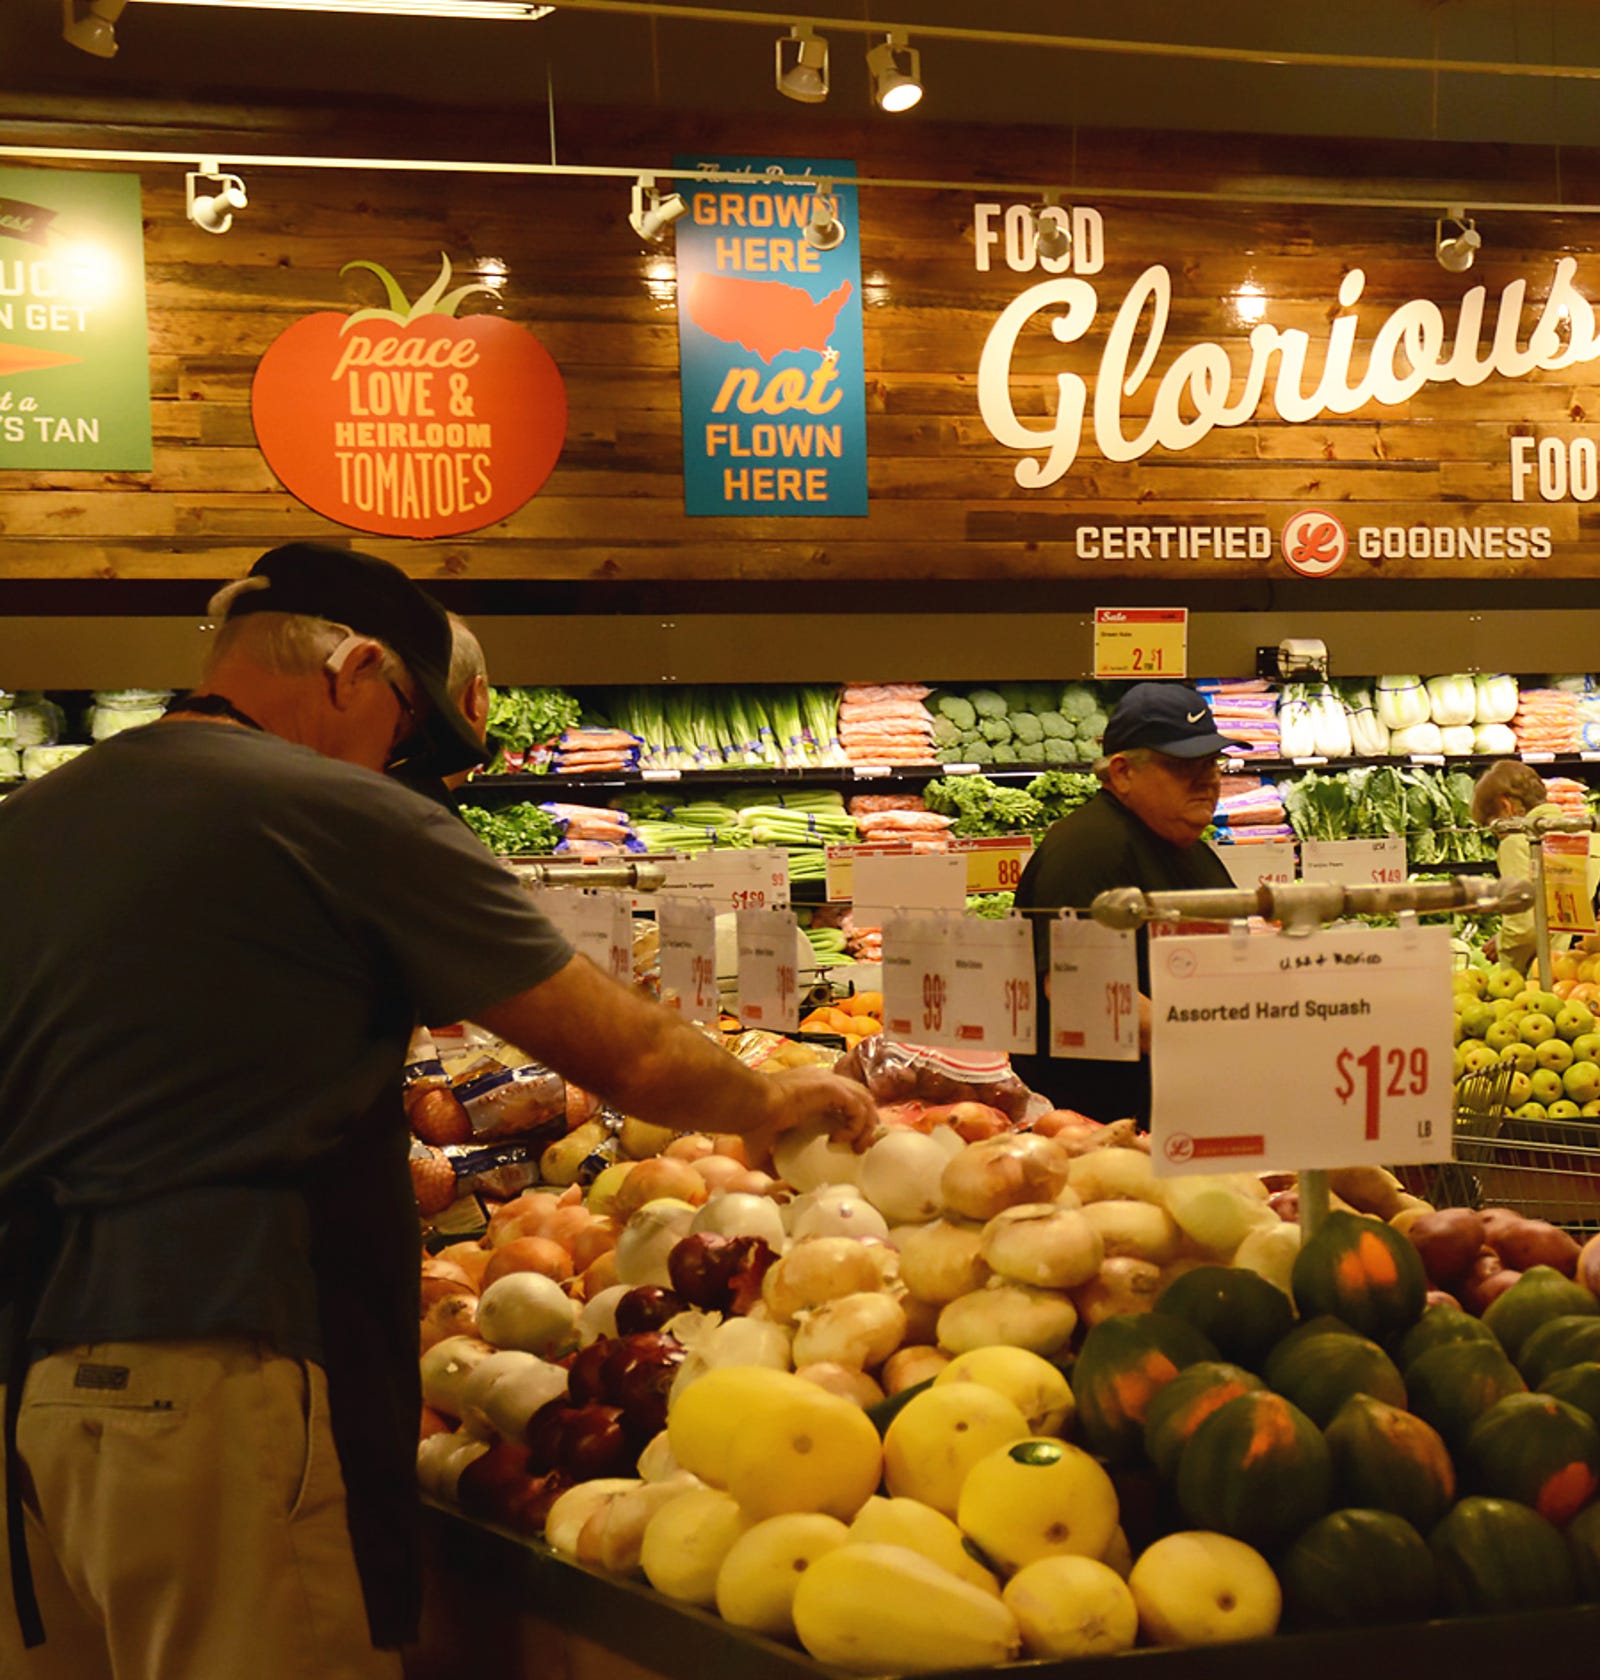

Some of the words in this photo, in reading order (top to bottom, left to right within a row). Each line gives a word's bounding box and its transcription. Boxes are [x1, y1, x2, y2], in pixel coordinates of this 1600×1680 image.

[715, 236, 822, 273] HERE
[26, 304, 92, 332] GET
[331, 336, 480, 381] peace
[349, 371, 435, 417] LOVE
[448, 372, 475, 417] &
[711, 350, 844, 415] not
[19, 396, 38, 412] a
[34, 417, 99, 443] TAN
[335, 421, 492, 448] HEIRLOOM
[705, 423, 843, 458] FLOWN
[335, 452, 493, 520] TOMATOES
[723, 467, 829, 501] HERE
[1075, 526, 1272, 560] CERTIFIED
[1359, 526, 1552, 560] GOODNESS
[1101, 611, 1128, 623] Sale
[1132, 648, 1143, 672] 2
[1167, 1000, 1250, 1023] Assorted
[1255, 1000, 1300, 1019] Hard
[1305, 998, 1371, 1021] Squash
[1335, 1044, 1429, 1141] $129
[1417, 1120, 1432, 1139] LB
